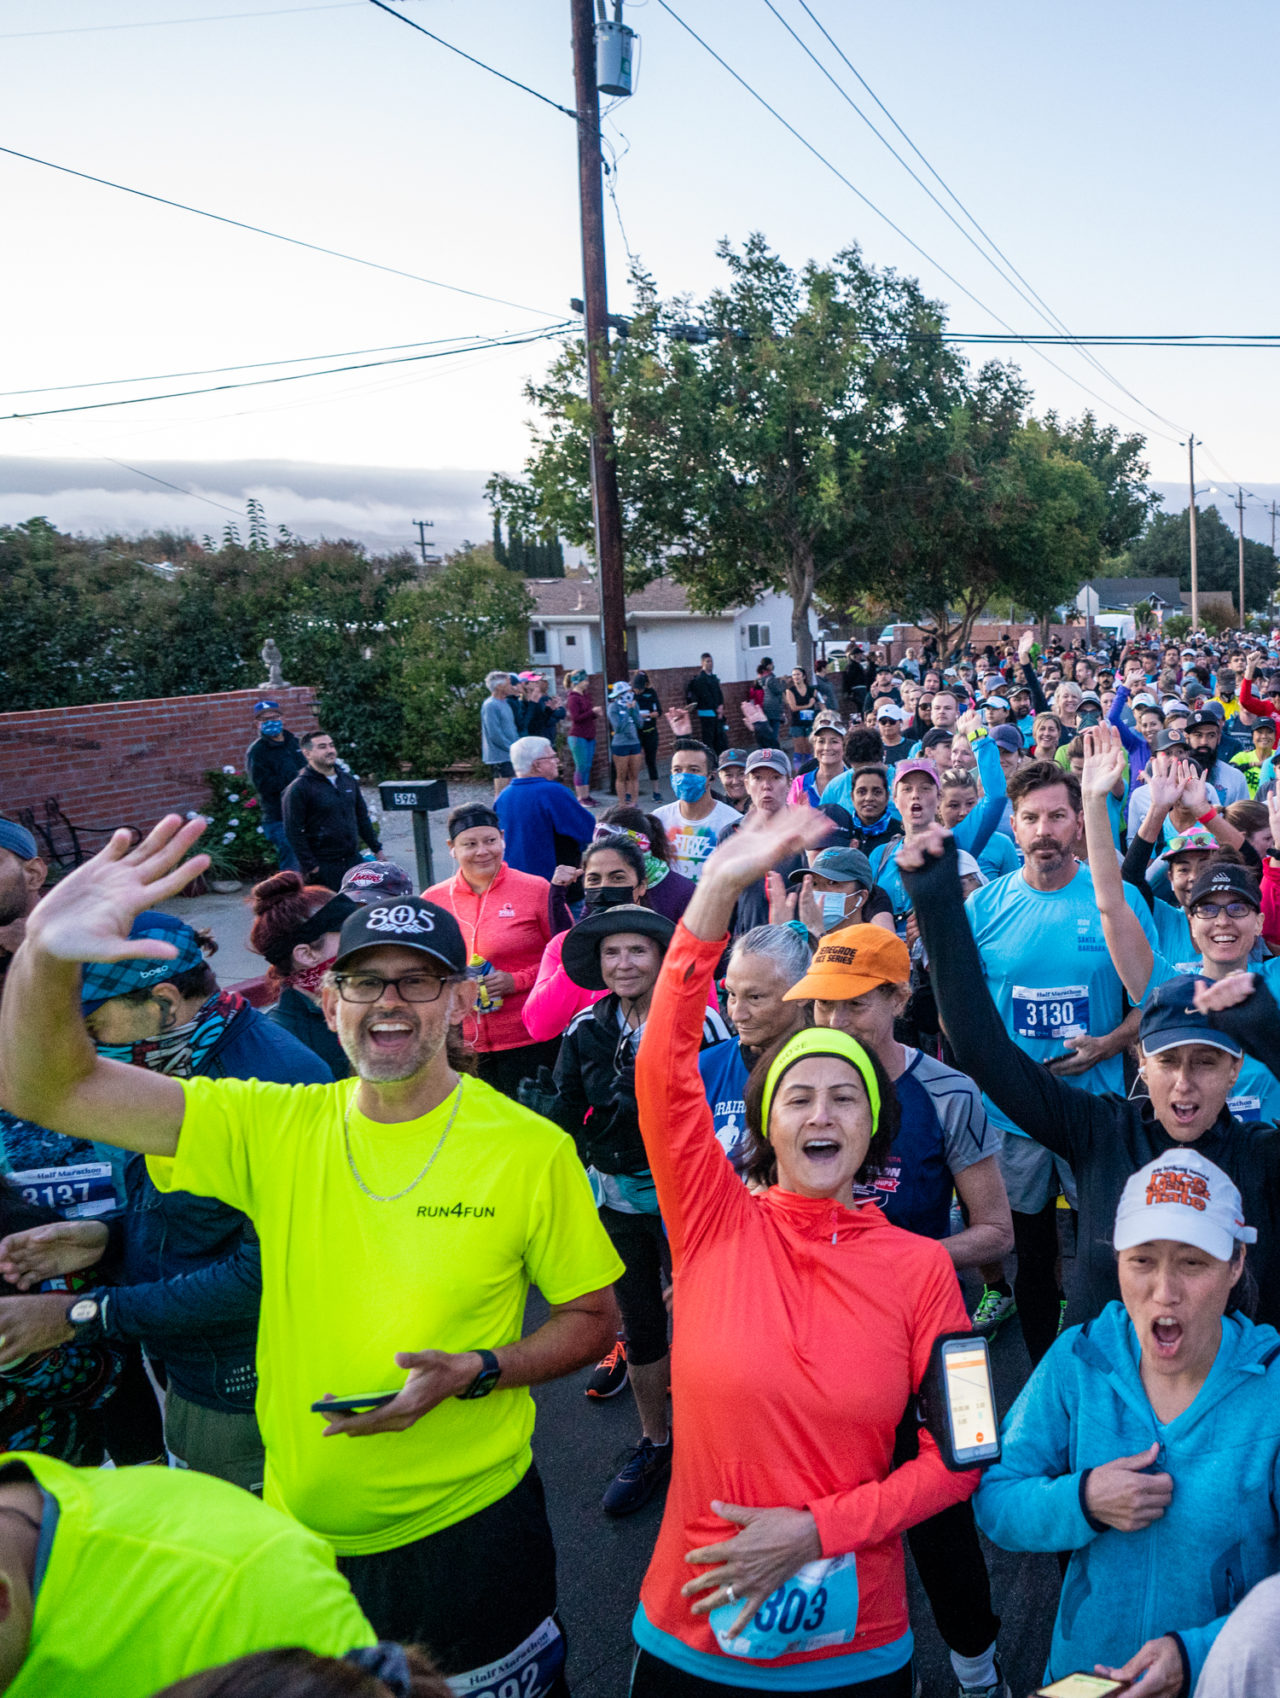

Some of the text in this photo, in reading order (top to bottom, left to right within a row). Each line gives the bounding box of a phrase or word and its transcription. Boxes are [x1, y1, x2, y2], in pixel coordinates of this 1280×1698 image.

[394, 792, 417, 805] 596
[366, 905, 435, 932] 805
[819, 946, 858, 957] ENEGADE
[827, 954, 853, 965] SERIES
[1051, 989, 1082, 997] Marathon
[1026, 1001, 1074, 1026] 3130
[37, 1167, 102, 1179] Half Marathon
[416, 1201, 495, 1218] RUN4FUN
[469, 1632, 549, 1686] Half Marathon
